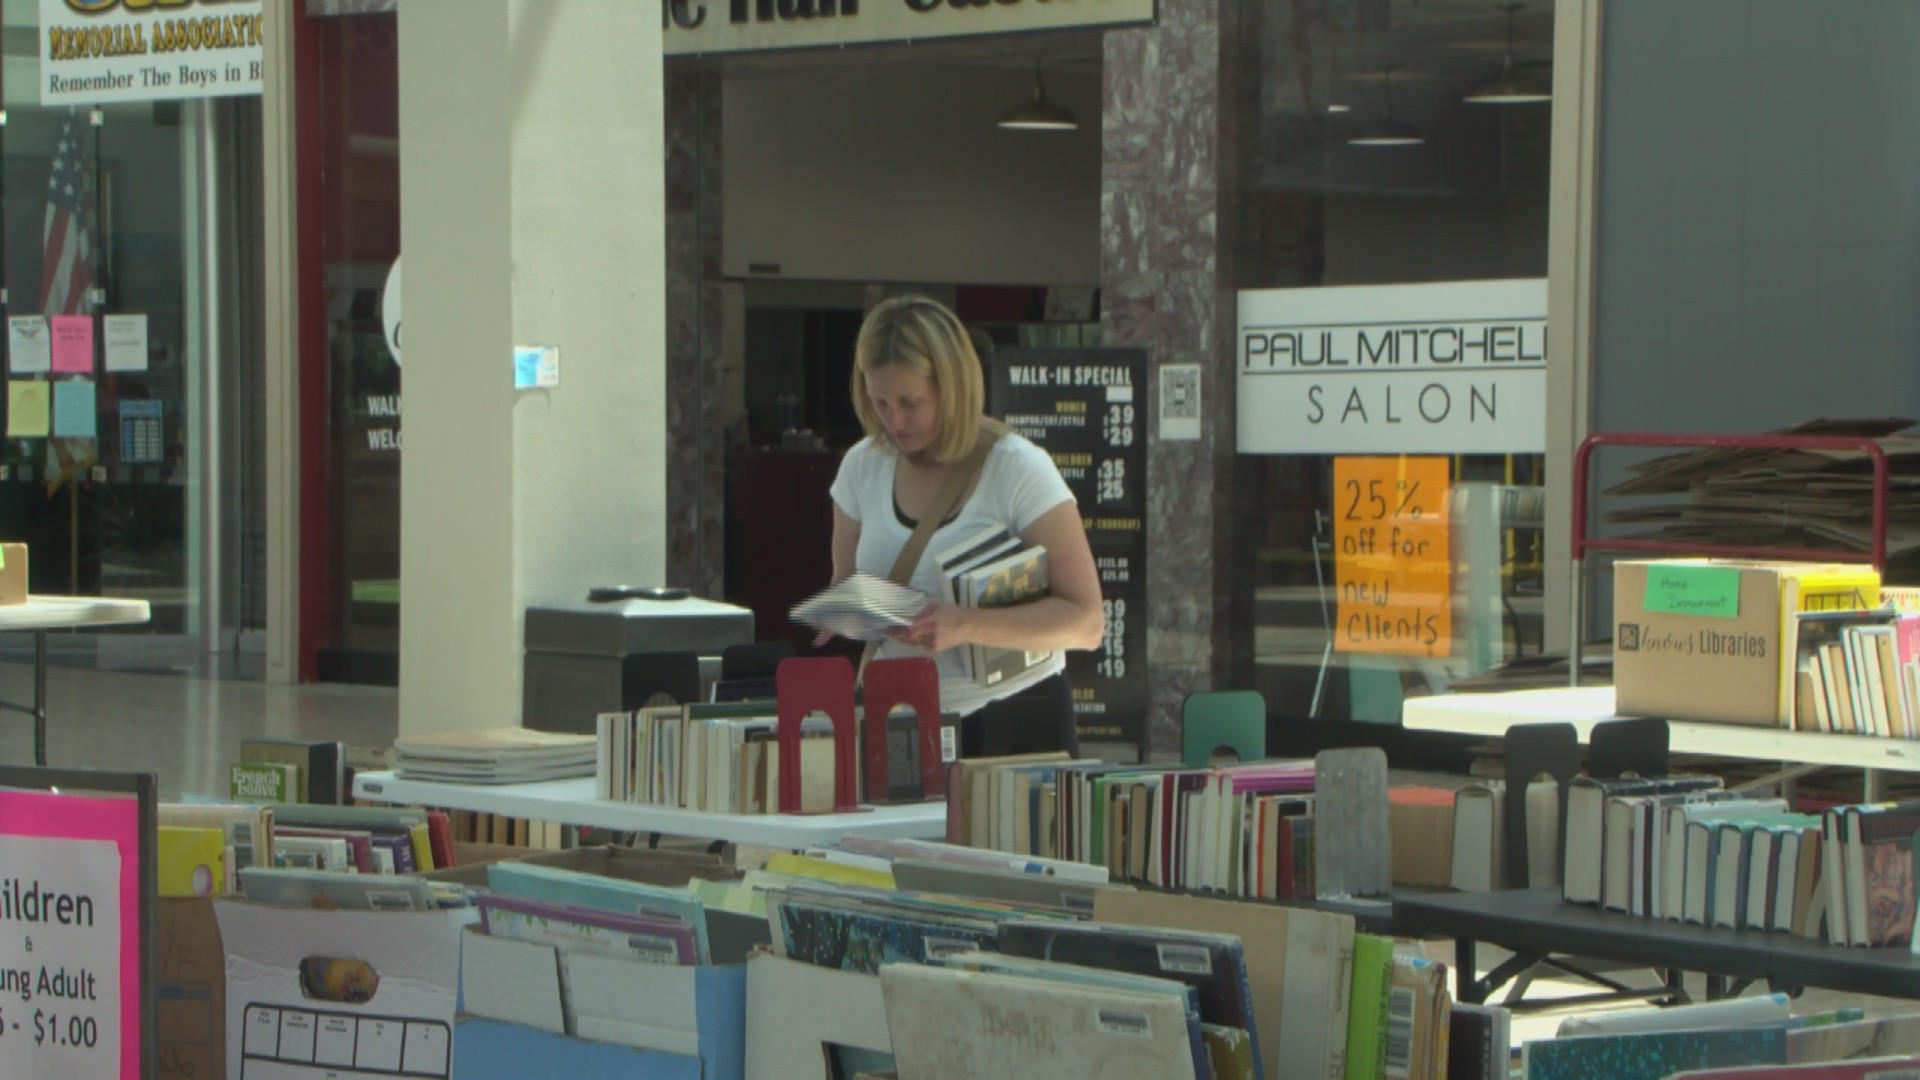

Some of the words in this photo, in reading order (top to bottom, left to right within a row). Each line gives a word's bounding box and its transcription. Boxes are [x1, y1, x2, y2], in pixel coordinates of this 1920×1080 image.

[50, 22, 147, 60] MEMORIAL
[50, 70, 133, 94] Remember
[140, 67, 171, 87] The
[179, 64, 217, 89] Boys
[225, 62, 241, 82] in
[1244, 331, 1349, 367] PAUL
[1357, 325, 1548, 366] MITCHEL
[1009, 366, 1071, 385] WALK-IN
[1075, 366, 1132, 386] SPECIAL
[1307, 382, 1497, 424] SALON
[1345, 479, 1423, 520] 25%
[1343, 527, 1376, 555] off
[1390, 527, 1430, 556] for
[1343, 578, 1389, 607] new
[1699, 629, 1766, 658] Libraries
[0, 878, 95, 927] ildren
[25, 935, 33, 952] &
[37, 965, 96, 1000] Adult
[34, 1007, 98, 1048] $1.00
